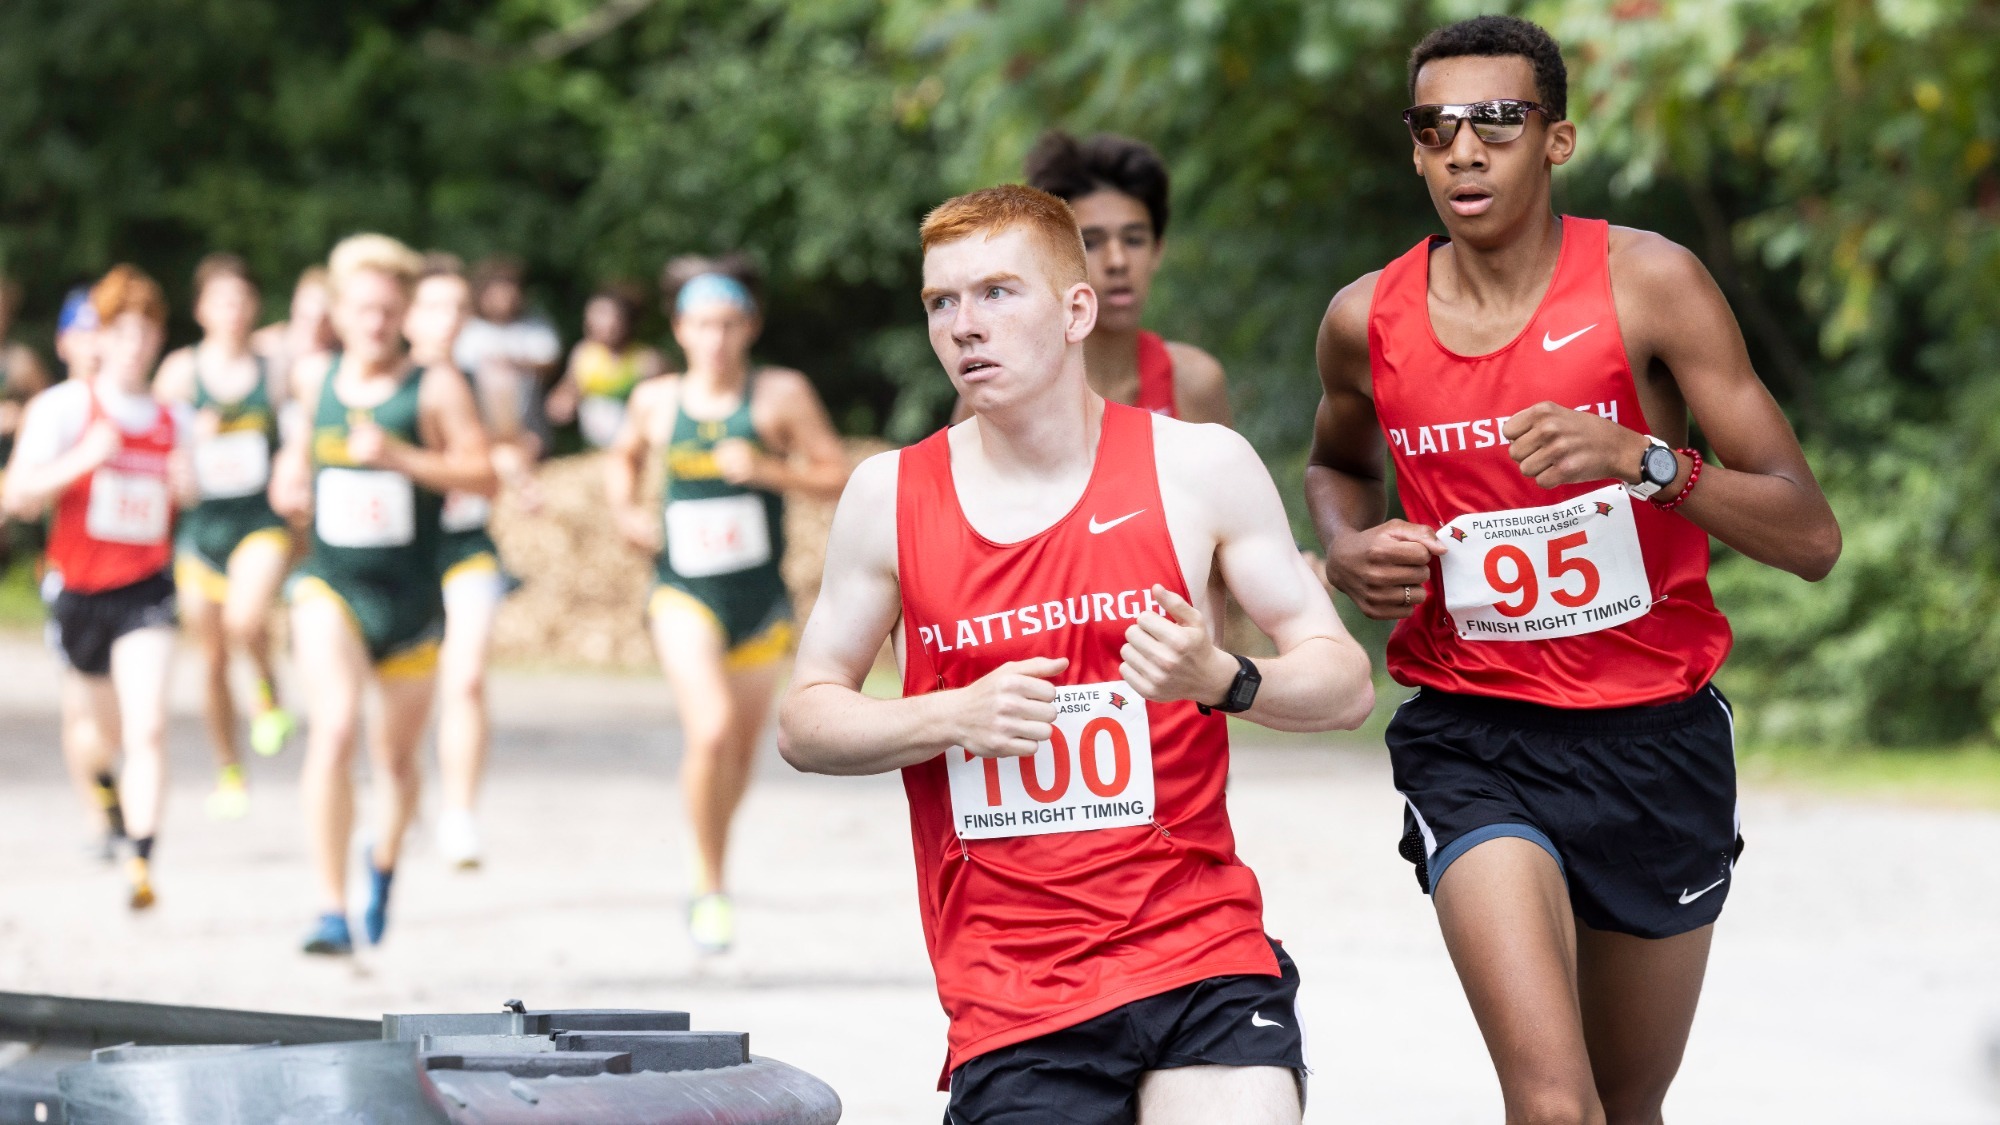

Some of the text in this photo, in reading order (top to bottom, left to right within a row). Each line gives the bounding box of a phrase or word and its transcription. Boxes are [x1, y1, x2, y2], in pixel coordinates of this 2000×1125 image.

[1472, 503, 1587, 530] PLATTSBURGH STATE
[1484, 517, 1580, 540] CARDINAL CLASSIC
[1483, 530, 1600, 618] 95
[918, 588, 1167, 655] PLATTSBURGH
[1466, 594, 1642, 634] FINISH RIGHT TIMING
[1056, 703, 1091, 715] ASSIC
[1064, 690, 1100, 702] STATE
[964, 716, 1132, 808] 100
[964, 800, 1145, 829] FINISH RIGHT TIMING
